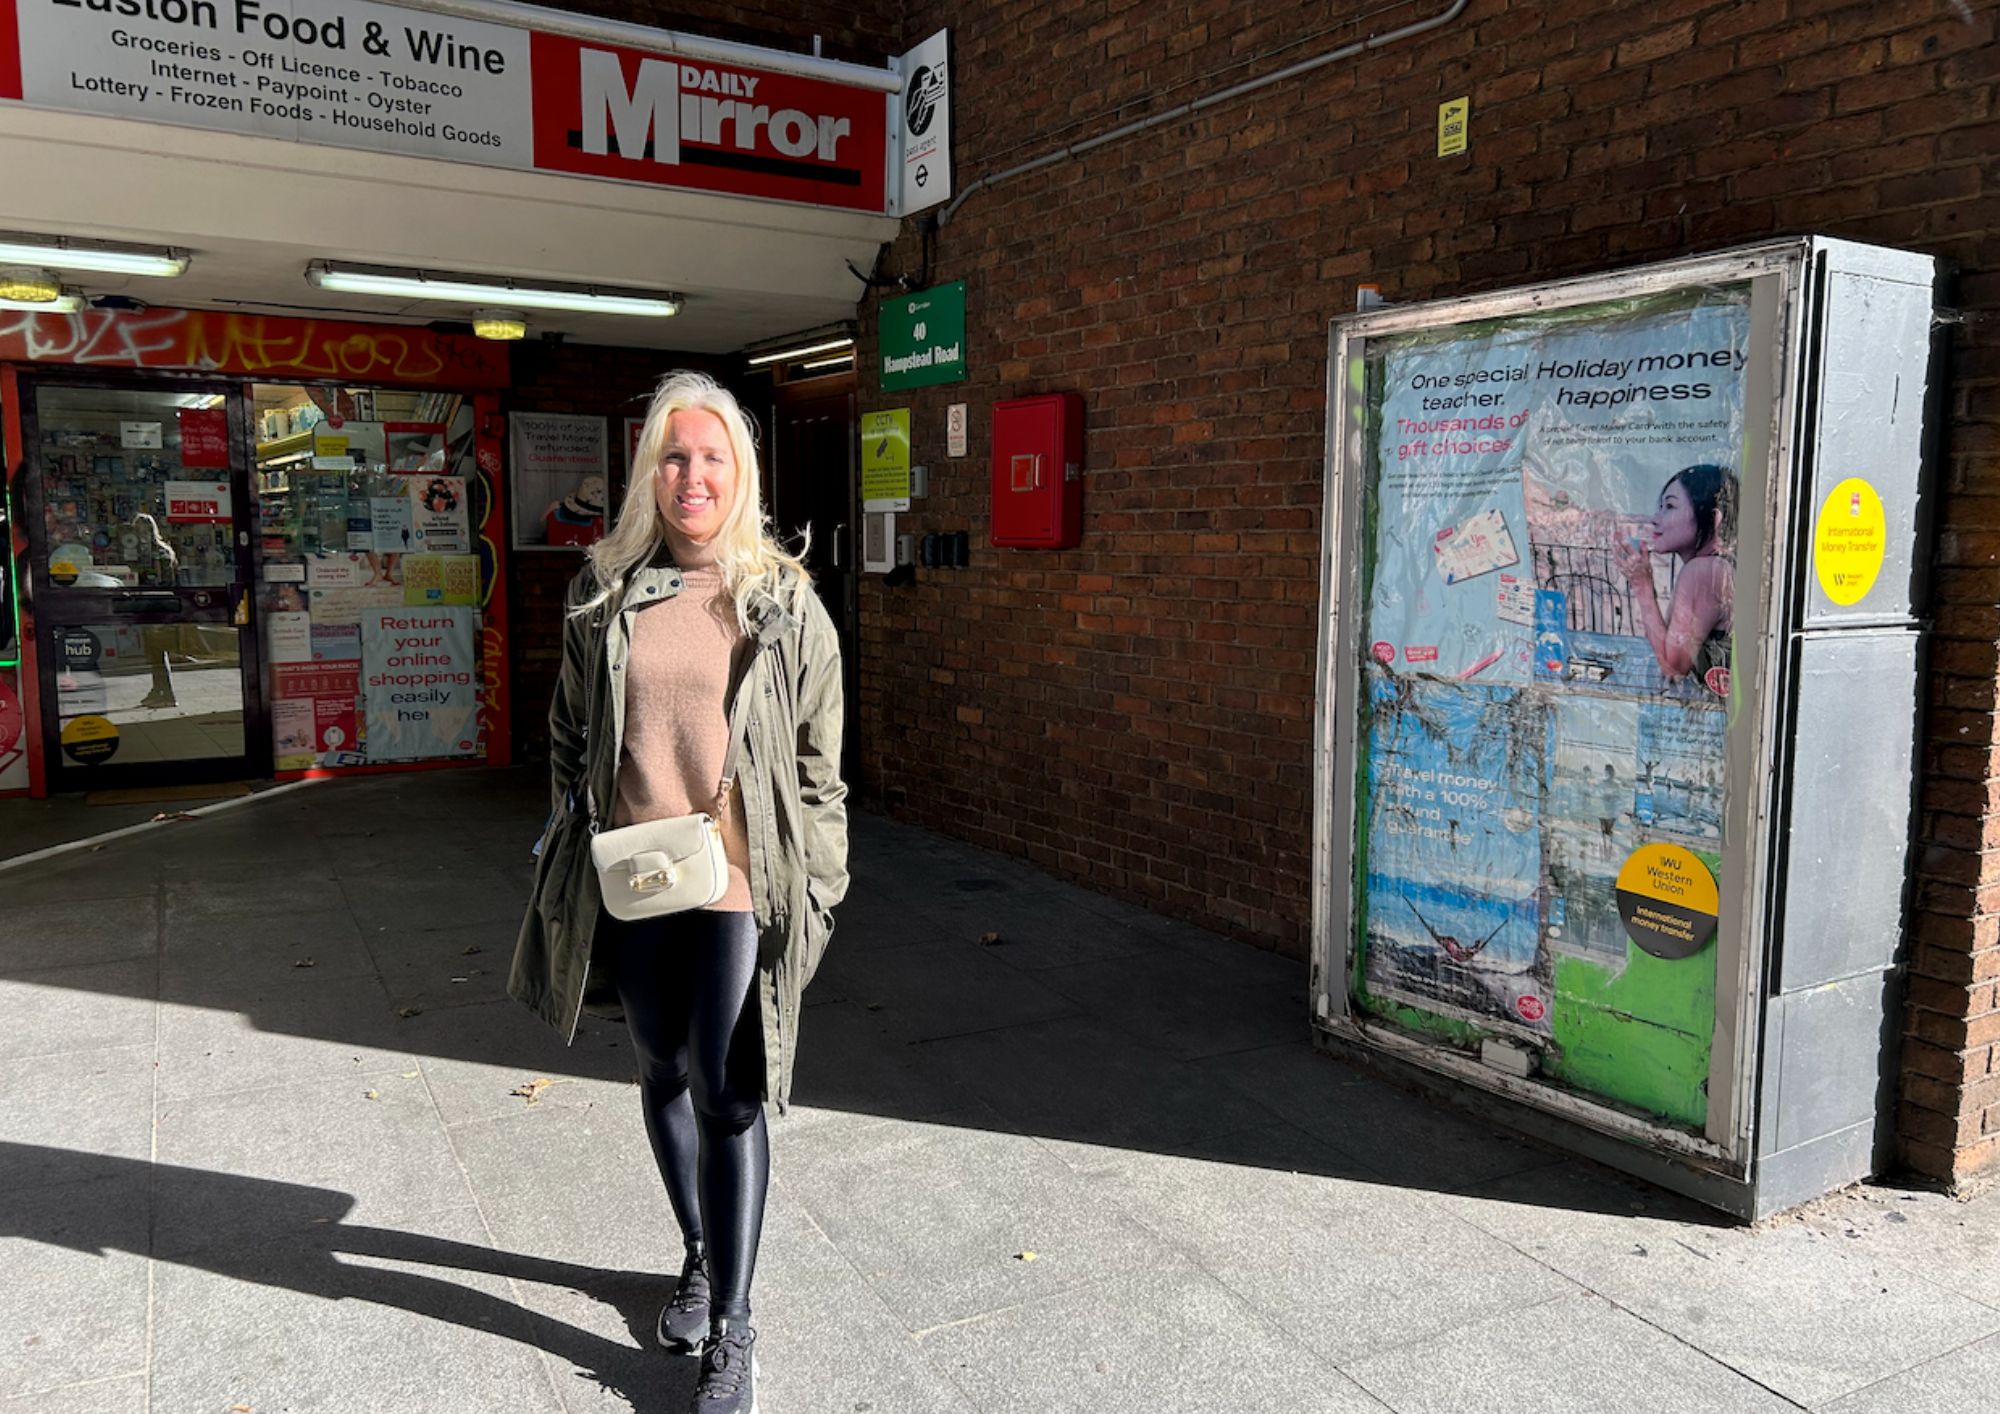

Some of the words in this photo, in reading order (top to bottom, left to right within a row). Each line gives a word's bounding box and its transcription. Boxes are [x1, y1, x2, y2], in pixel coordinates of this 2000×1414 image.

[52, 0, 218, 29] ston
[235, 0, 346, 50] Food
[362, 20, 391, 57] &
[404, 26, 505, 75] Wine
[111, 29, 221, 62] Groceries
[243, 49, 274, 69] Off
[281, 55, 361, 82] Licence
[379, 70, 463, 98] Tobacco
[151, 59, 237, 88] Internet
[257, 75, 348, 103] Paypoint
[367, 91, 431, 116] Oyster
[681, 64, 760, 98] DAILY
[71, 71, 149, 102] Lottery
[171, 86, 243, 112] Frozen
[250, 97, 313, 122] Foods
[333, 108, 436, 139] Household
[442, 124, 502, 147] Goods
[579, 46, 850, 166] Mirror
[912, 321, 927, 341] 40
[883, 347, 932, 374] Hampstead
[933, 341, 959, 364] Road
[1536, 358, 1634, 381] Holiday
[1637, 348, 1748, 372] money
[1411, 373, 1450, 390] One
[1453, 363, 1530, 389] special
[1422, 391, 1506, 411] teacher.
[1556, 382, 1713, 410] happiness
[1397, 413, 1505, 434] Thousands
[1509, 408, 1530, 428] of
[1677, 419, 1695, 429] the
[1648, 434, 1672, 444] bank
[1397, 439, 1428, 461] gift
[380, 616, 455, 630] Return
[65, 643, 92, 656] hub
[394, 636, 442, 651] your
[387, 652, 451, 667] online
[368, 671, 470, 687] shopping
[391, 689, 451, 704] easily
[397, 708, 430, 721] her
[1437, 772, 1499, 793] money
[1424, 789, 1435, 801] a
[1440, 790, 1488, 810] 100%
[1647, 865, 1693, 886] Western
[1653, 879, 1684, 896] Union
[1631, 915, 1660, 932] money
[1660, 924, 1696, 941] transfer
[1636, 905, 1693, 930] International
